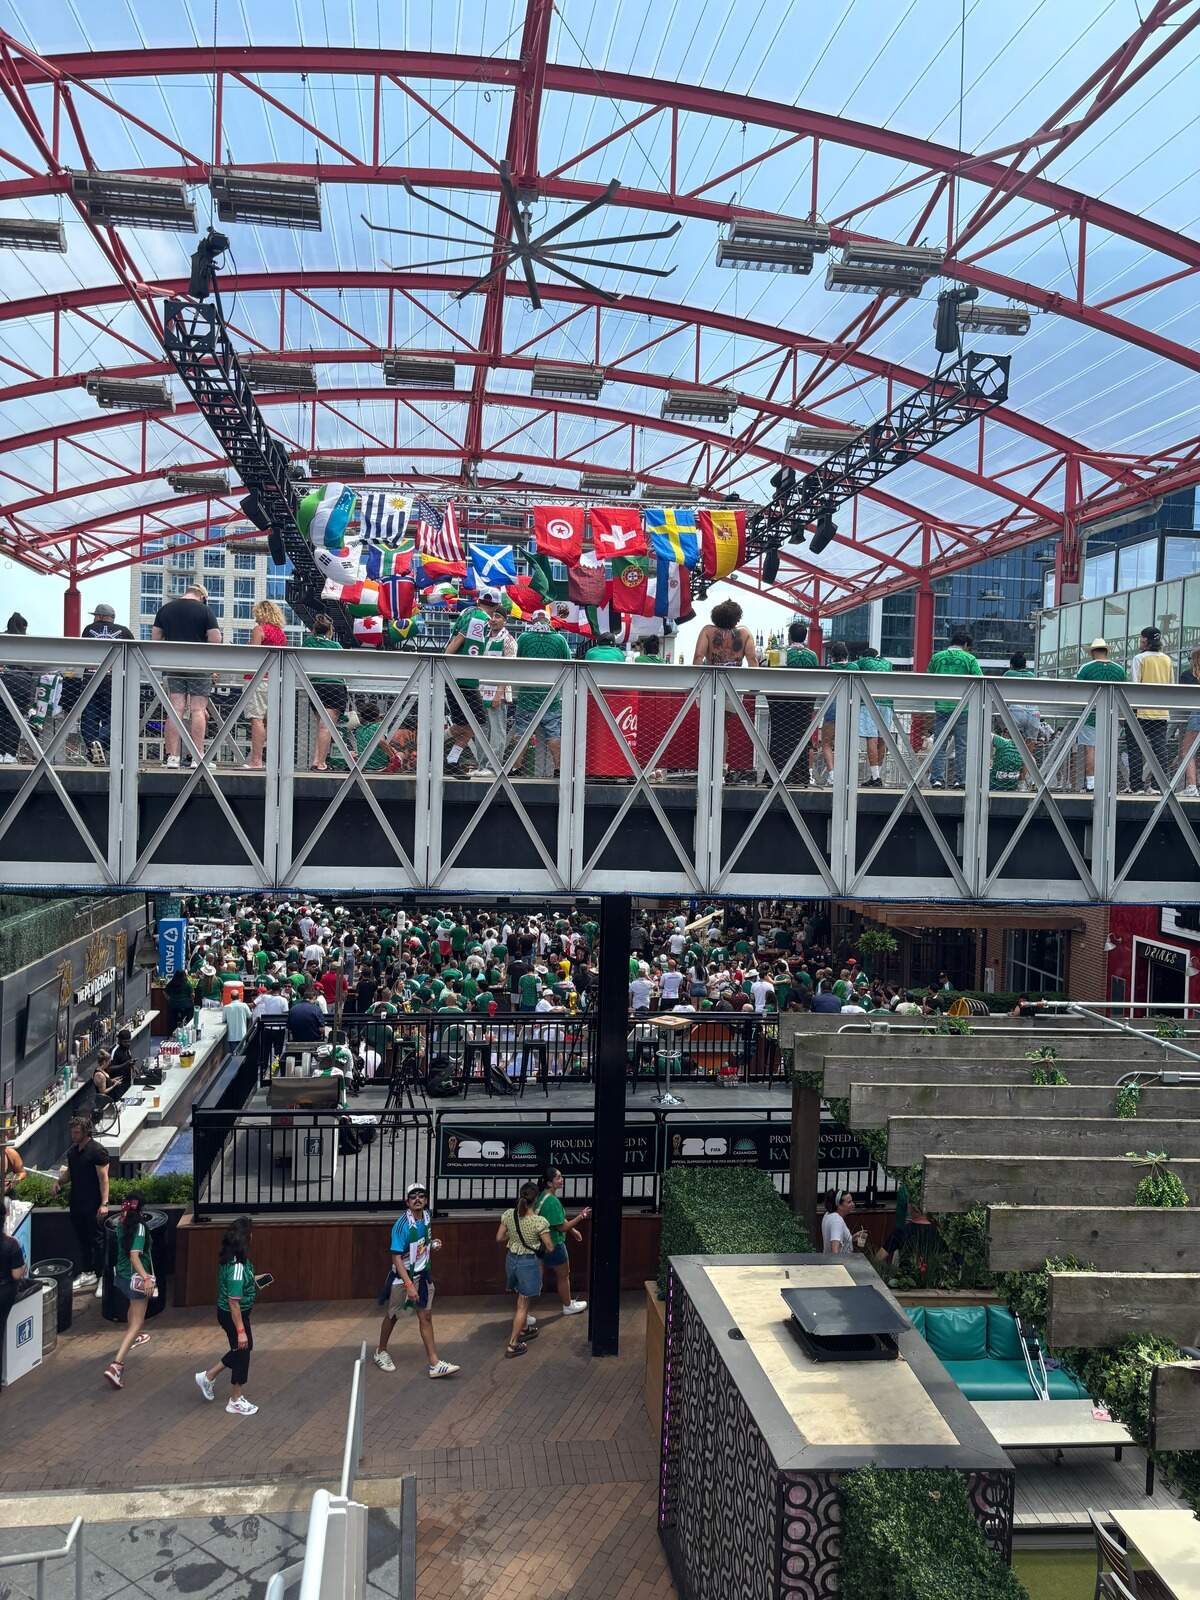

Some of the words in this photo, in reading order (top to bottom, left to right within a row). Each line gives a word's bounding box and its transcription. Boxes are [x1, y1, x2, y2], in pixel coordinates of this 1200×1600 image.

[1144, 945, 1177, 963] DRINKS
[166, 945, 174, 984] FANDU
[458, 1140, 506, 1159] 26
[550, 1139, 593, 1148] PROUDLY
[638, 1137, 647, 1147] IN
[550, 1152, 593, 1165] KANS
[624, 1150, 648, 1163] ITY
[830, 1146, 863, 1159] CITY
